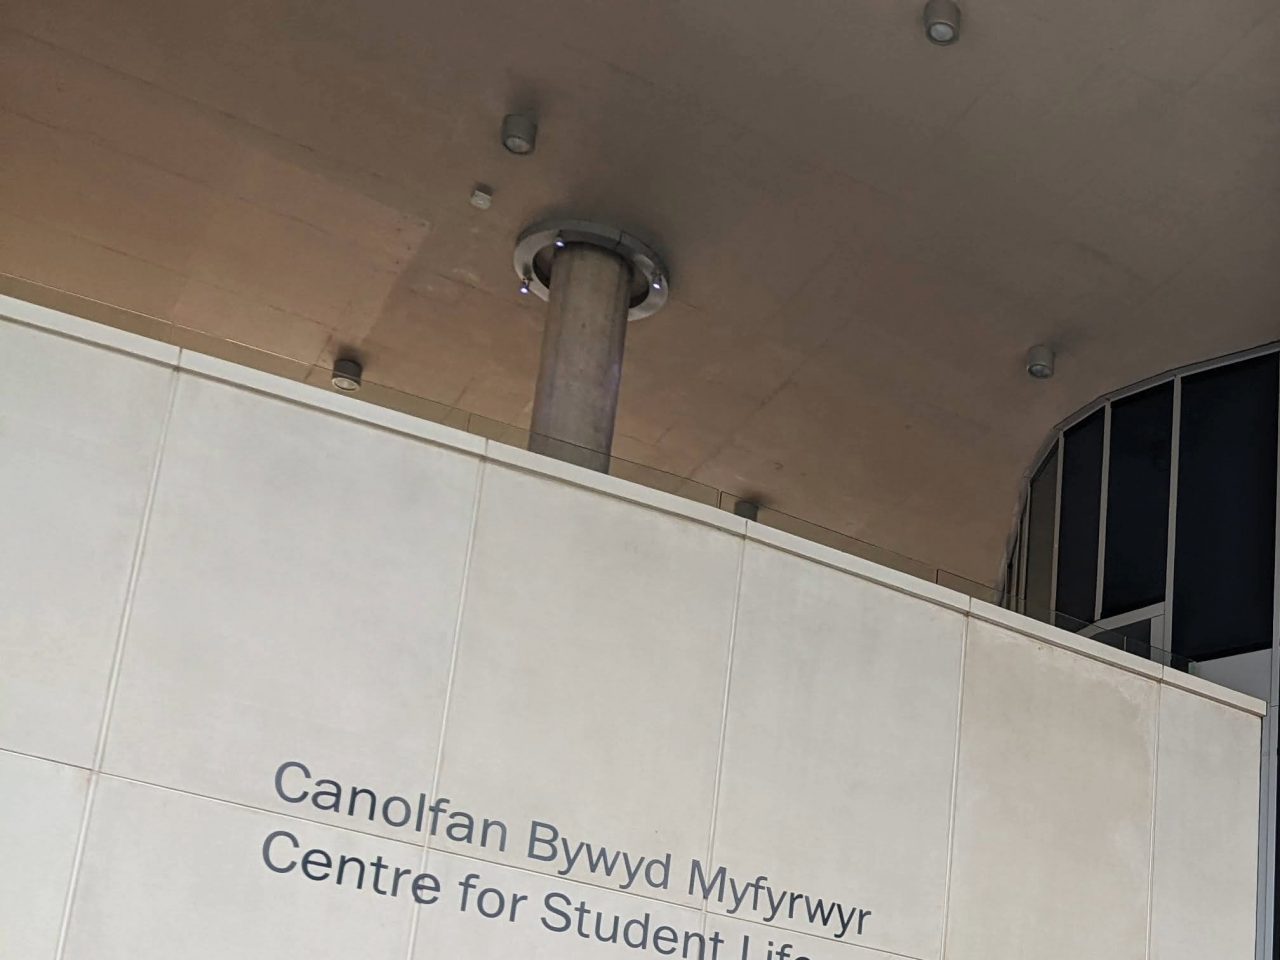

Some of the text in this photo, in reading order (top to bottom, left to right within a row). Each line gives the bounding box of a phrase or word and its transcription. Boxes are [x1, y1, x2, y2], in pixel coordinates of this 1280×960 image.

[262, 831, 441, 905] Centre
[458, 874, 528, 922] for
[274, 761, 872, 938] Canolfan Bywyd Myfyrwyr
